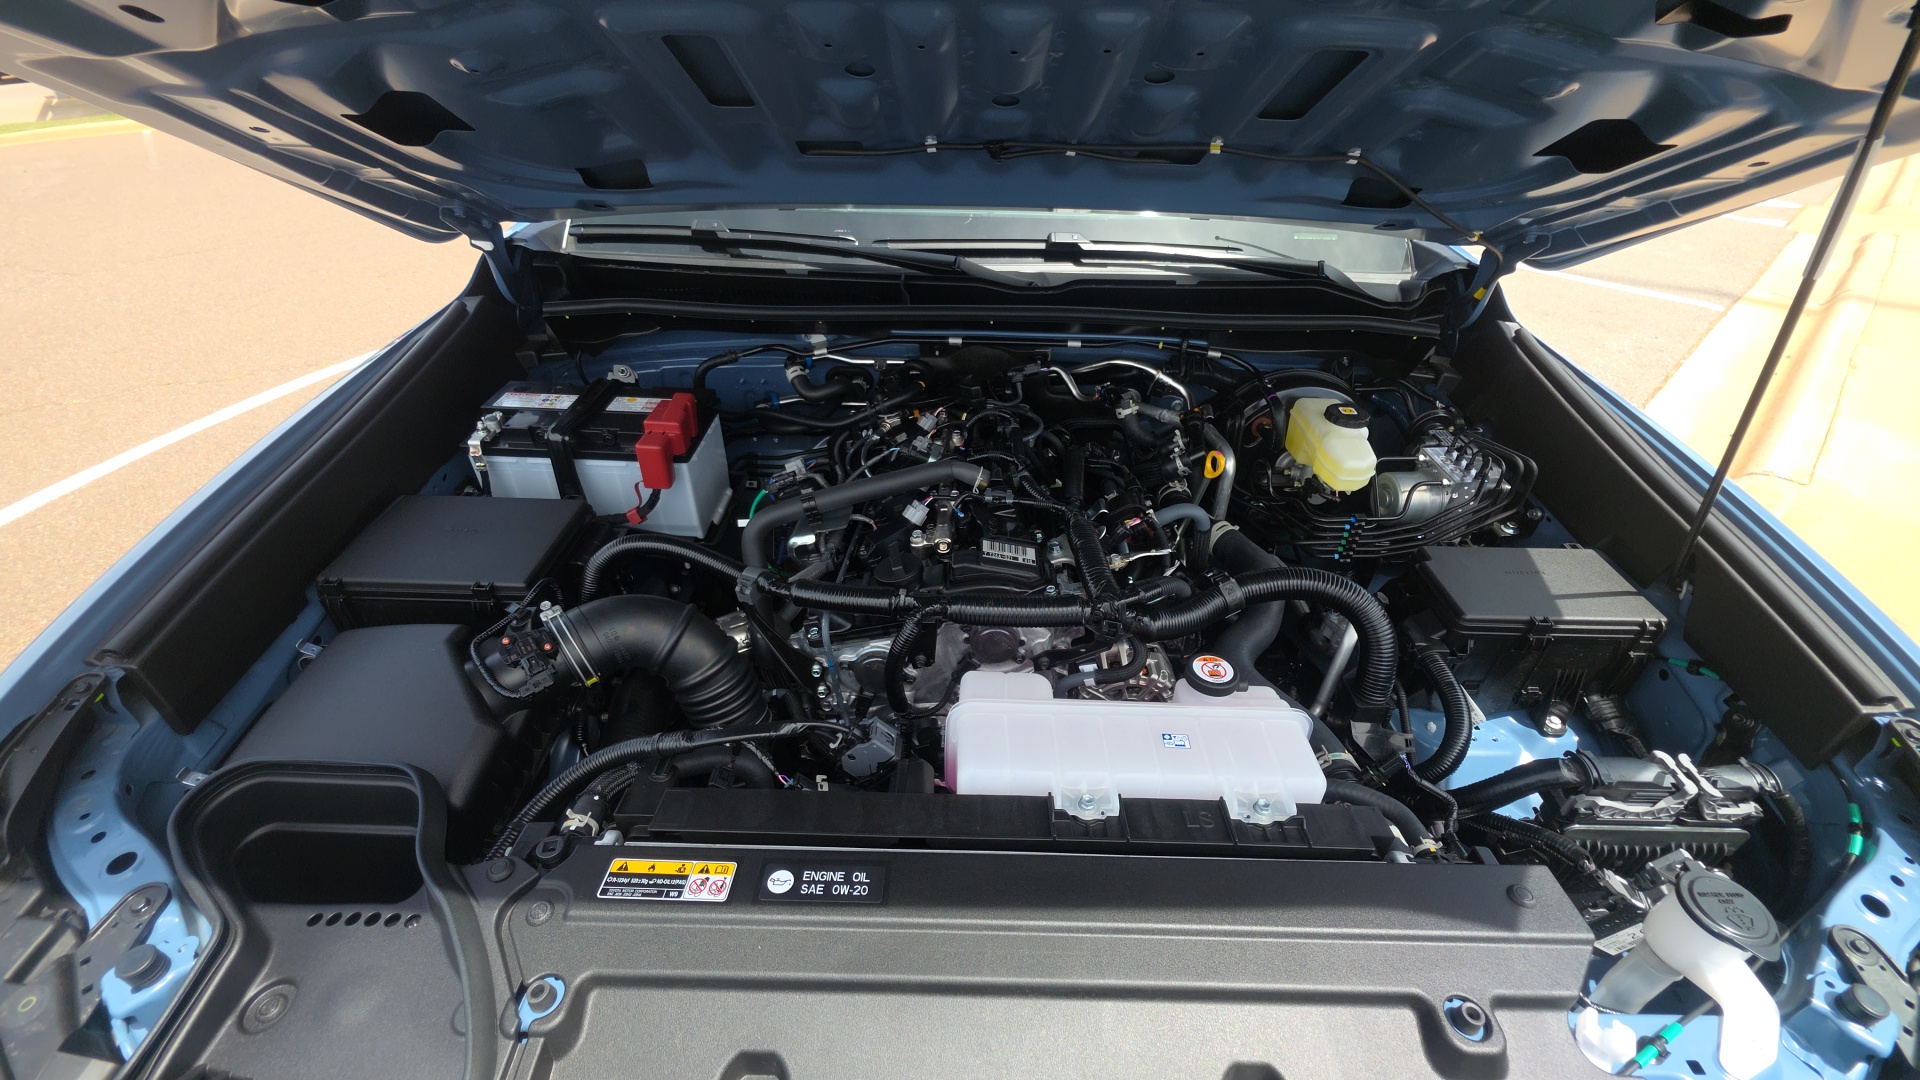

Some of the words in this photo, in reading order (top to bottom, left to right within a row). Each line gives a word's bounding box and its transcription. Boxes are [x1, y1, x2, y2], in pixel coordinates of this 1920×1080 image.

[1183, 810, 1214, 828] LS
[803, 871, 845, 882] ENGINE
[852, 872, 870, 882] OIL
[800, 884, 825, 895] SAE
[832, 885, 869, 896] 0W-20
